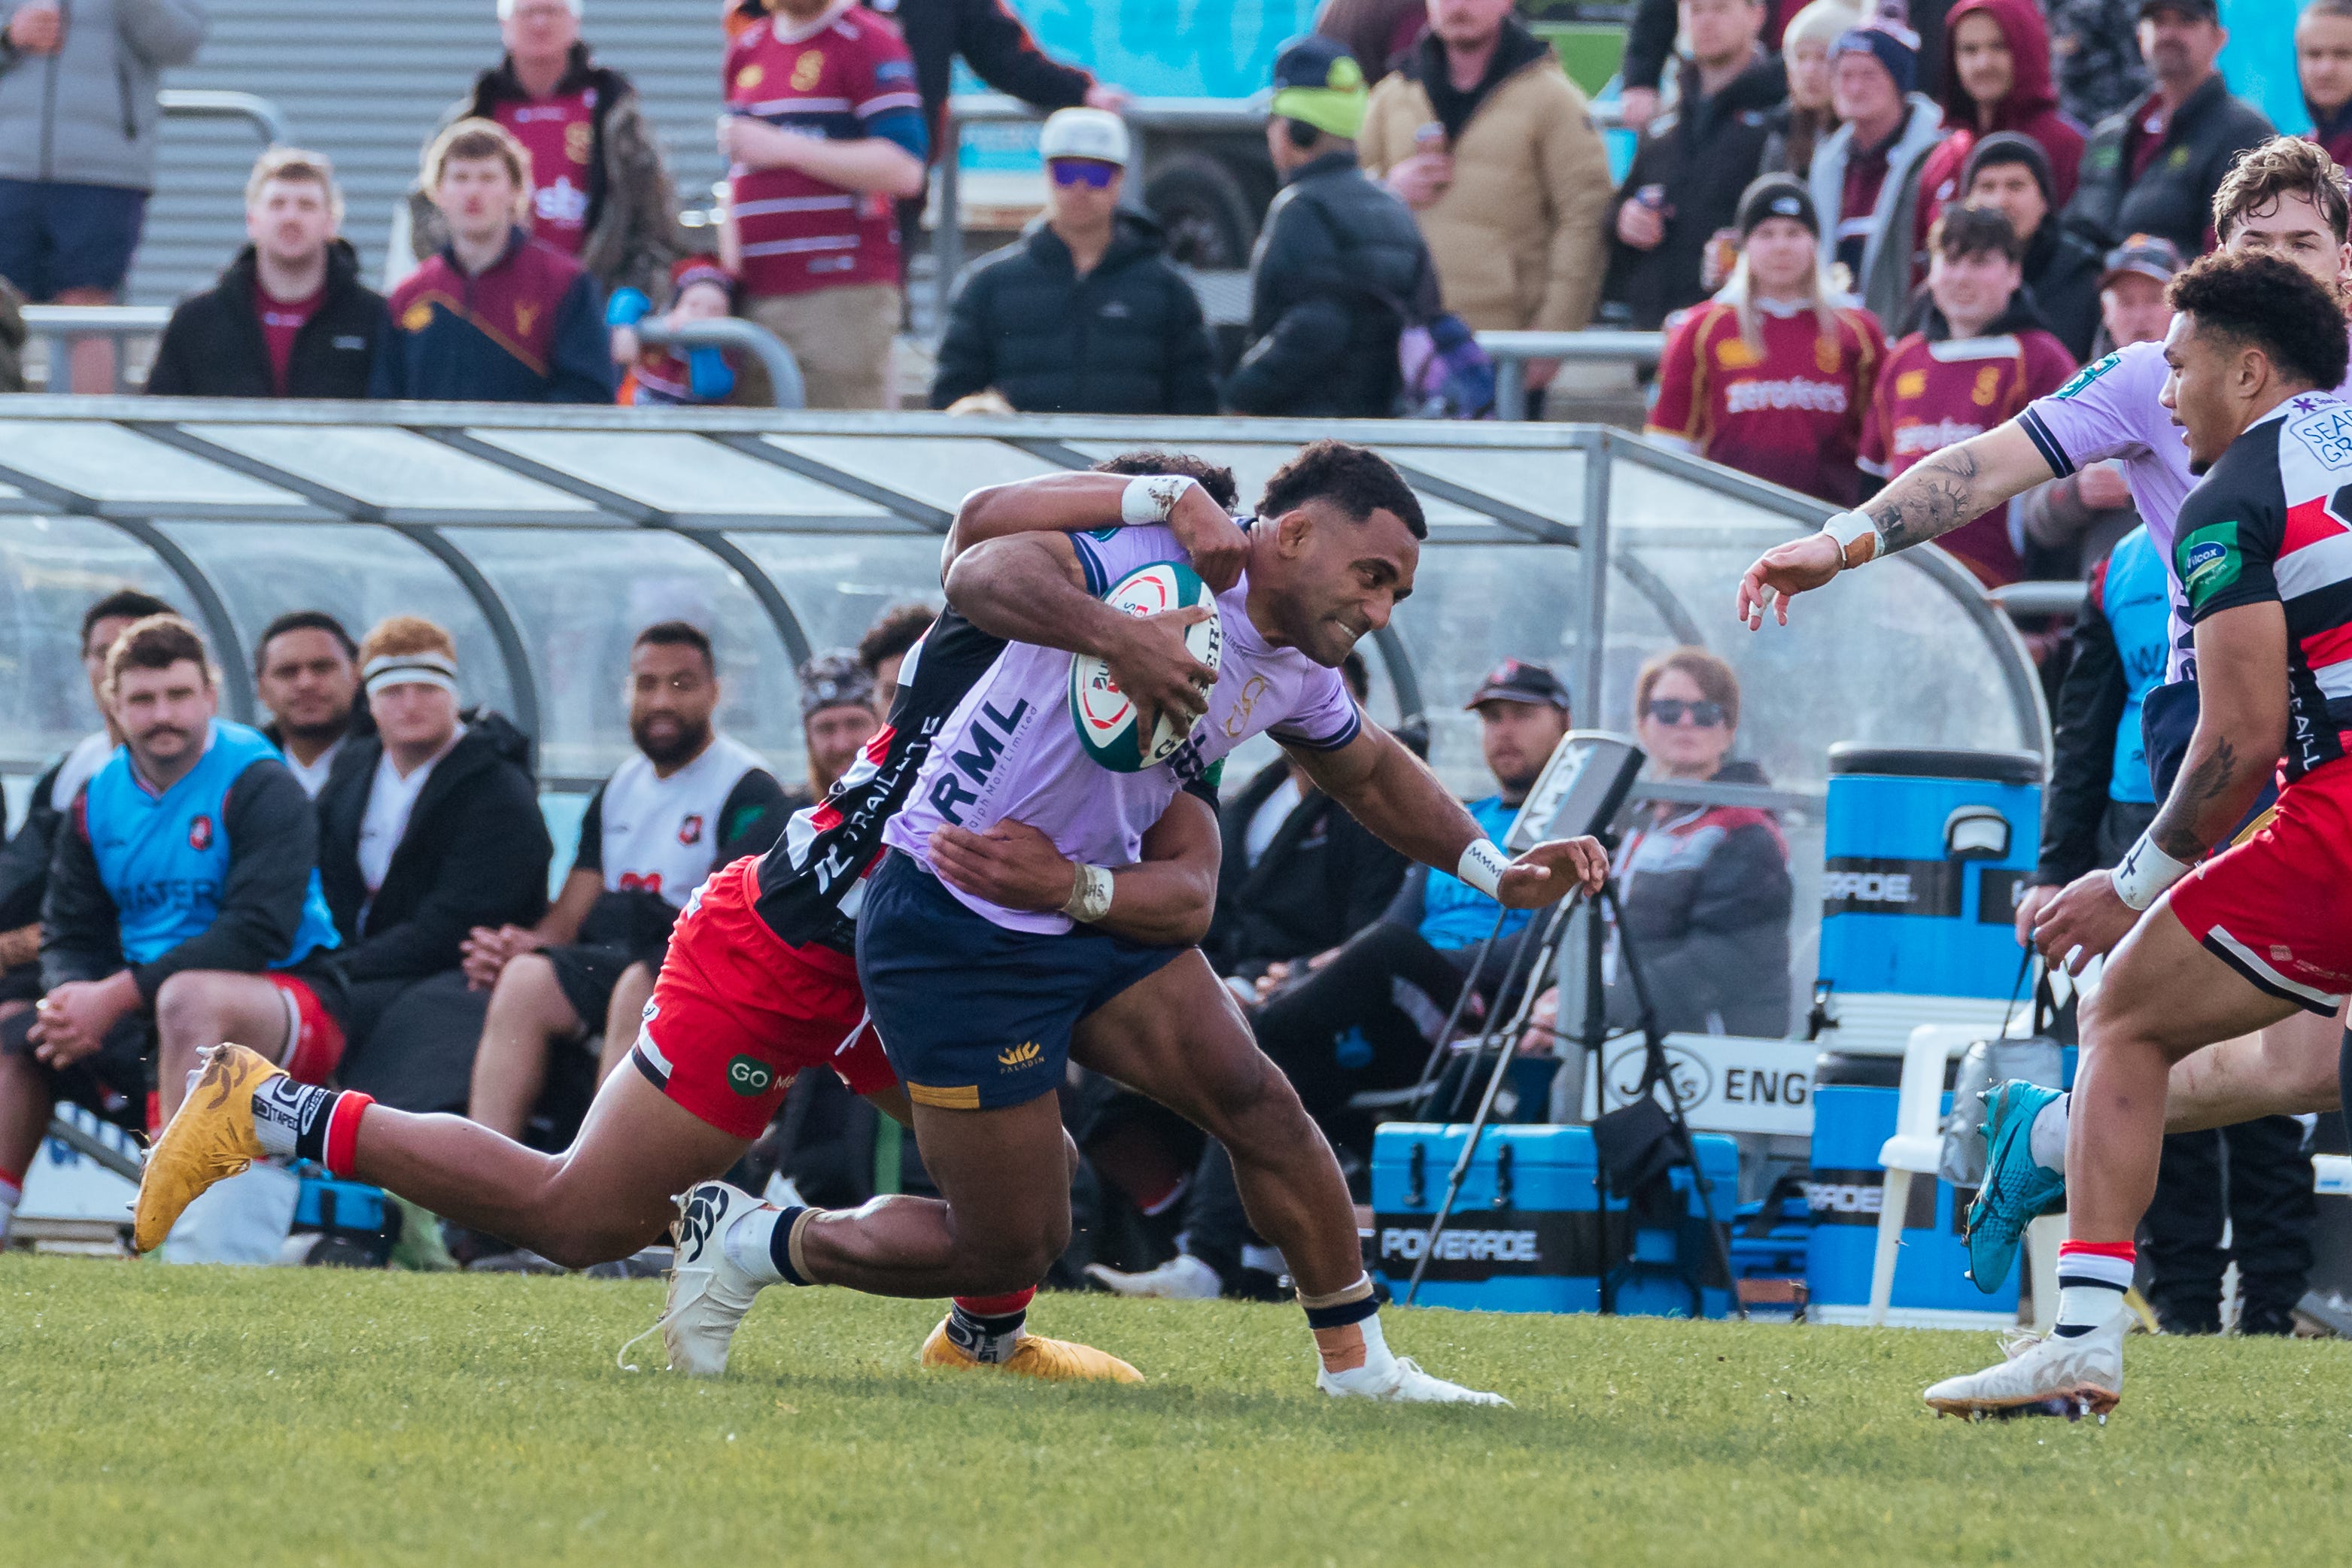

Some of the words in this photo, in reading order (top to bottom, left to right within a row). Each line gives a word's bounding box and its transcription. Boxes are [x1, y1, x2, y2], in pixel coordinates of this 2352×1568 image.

[1004, 705, 1038, 762] Limited
[928, 697, 1029, 826] RML
[1522, 742, 1597, 842] APEX
[731, 1062, 768, 1088] GO
[1000, 1056, 1045, 1075] PALADIN
[1725, 1068, 1806, 1105] ENG
